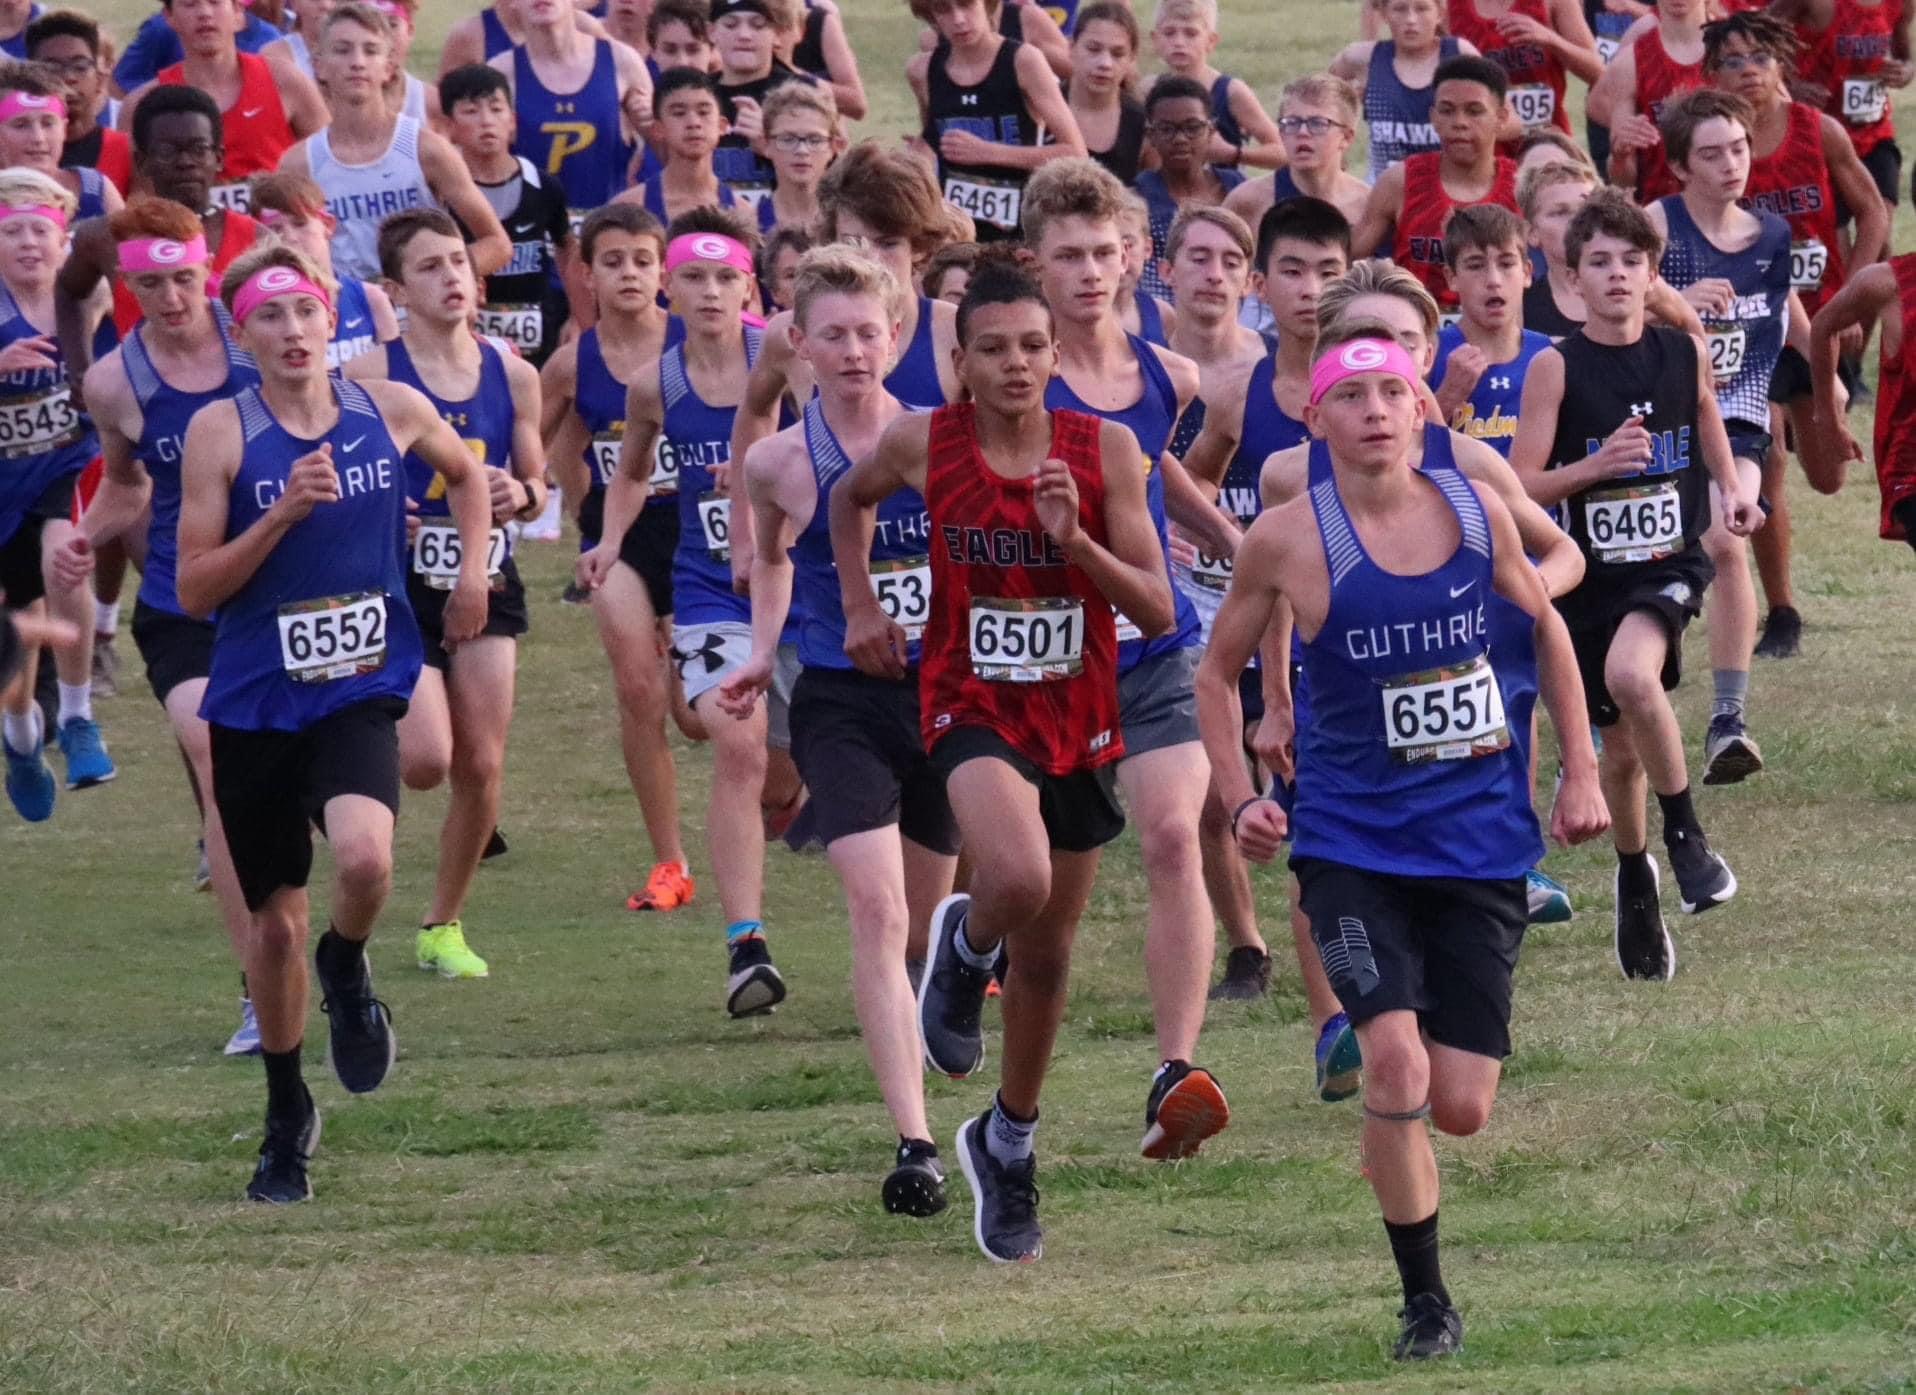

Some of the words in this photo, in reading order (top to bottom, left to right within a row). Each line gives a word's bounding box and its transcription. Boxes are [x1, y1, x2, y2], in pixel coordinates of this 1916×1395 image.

[541, 122, 597, 176] P
[949, 184, 1012, 220] 6461
[1791, 253, 1822, 280] 05
[1710, 336, 1741, 370] 25
[1592, 499, 1676, 543] 6465
[420, 531, 500, 570] 657
[941, 524, 1072, 567] EAGLE
[878, 575, 927, 620] 53
[288, 606, 382, 662] 6552
[975, 614, 1073, 660] 6501
[1346, 602, 1487, 660] GUTHRIE
[1392, 677, 1492, 739] 6557
